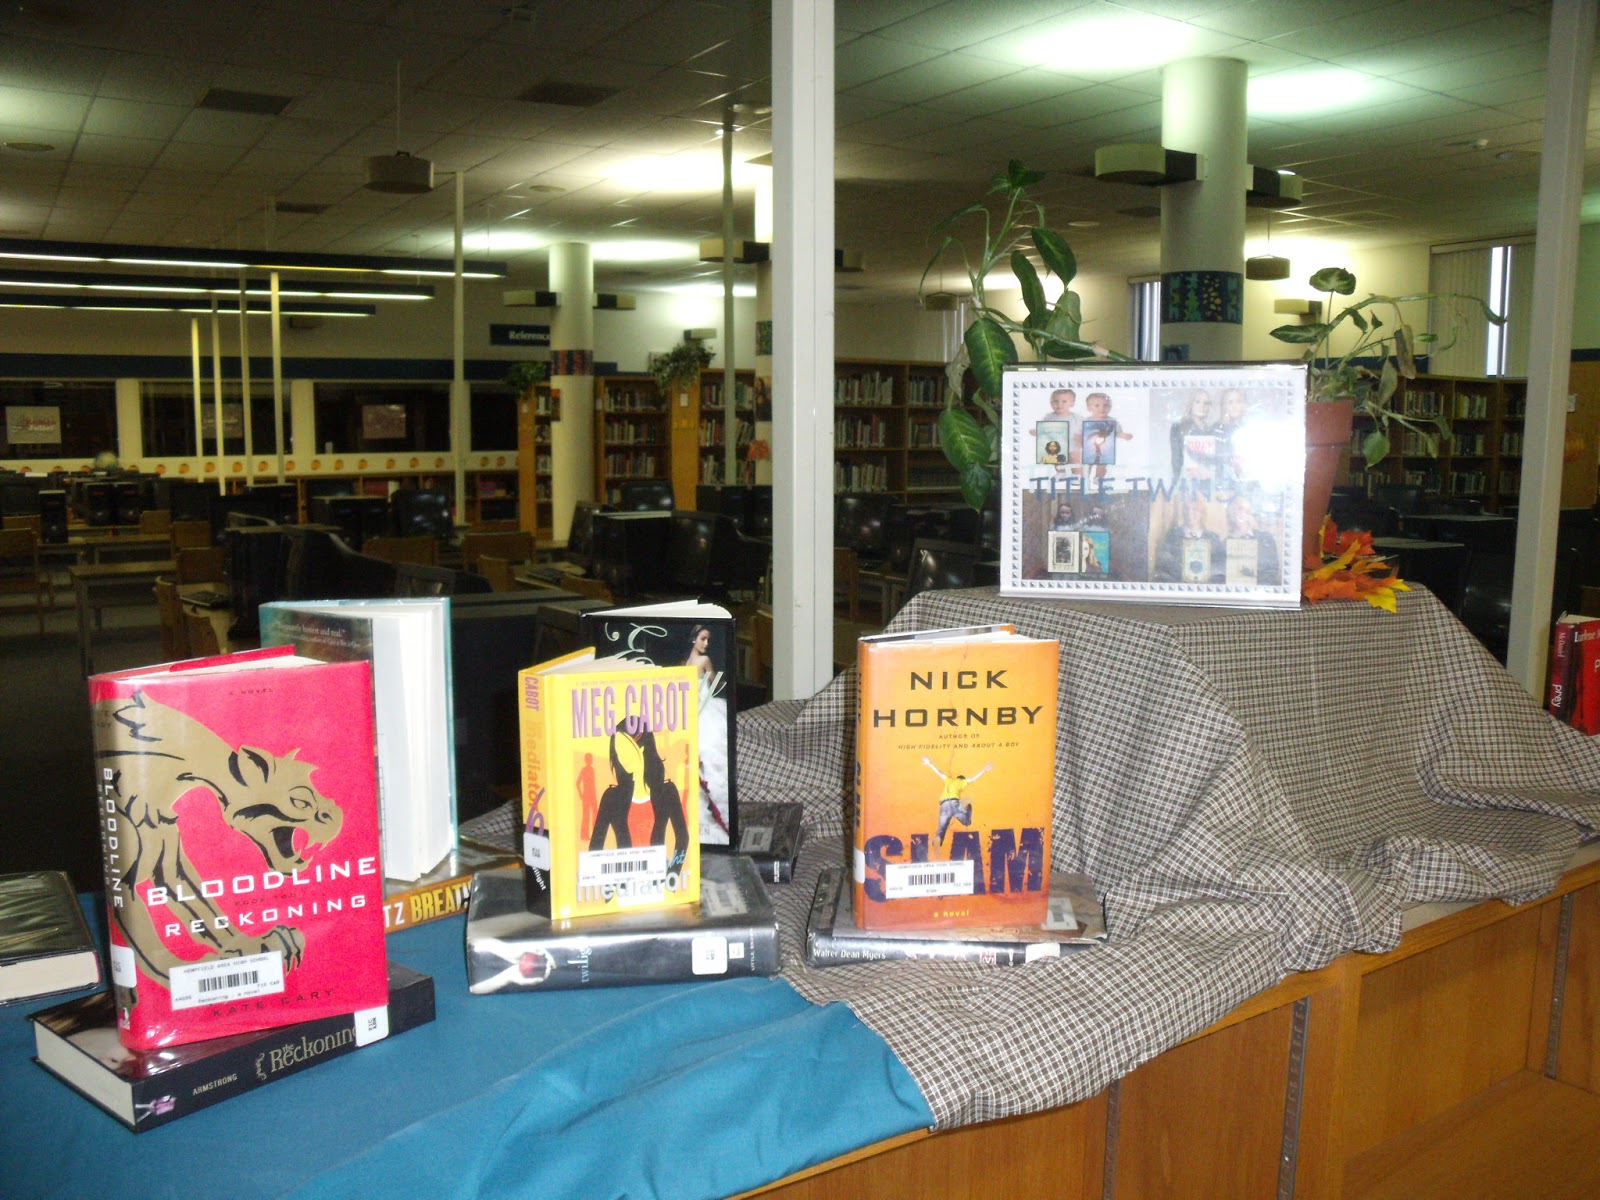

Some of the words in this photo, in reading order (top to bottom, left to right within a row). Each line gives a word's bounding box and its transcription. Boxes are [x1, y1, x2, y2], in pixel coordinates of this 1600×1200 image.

[1029, 475, 1121, 501] TITLE
[910, 669, 1009, 691] NICK
[524, 676, 540, 712] CABOT
[1551, 684, 1562, 708] prey
[571, 686, 617, 738] MEG
[625, 682, 690, 735] CABOT
[873, 705, 1044, 728] HORNBY
[103, 767, 123, 908] BLOODLINE
[147, 857, 376, 907] BLOODLINE
[532, 866, 547, 891] ilight
[165, 894, 366, 937] RECKONING
[383, 901, 405, 928] TZ
[410, 880, 473, 924] BREAT
[943, 910, 970, 918] novel
[567, 944, 593, 983] twilig
[813, 948, 838, 958] Walter
[840, 950, 860, 959] Dean
[862, 951, 886, 961] Myers
[213, 1001, 265, 1017] KATE
[281, 988, 334, 1005] CARY
[192, 1073, 238, 1096] ARMSTRONG
